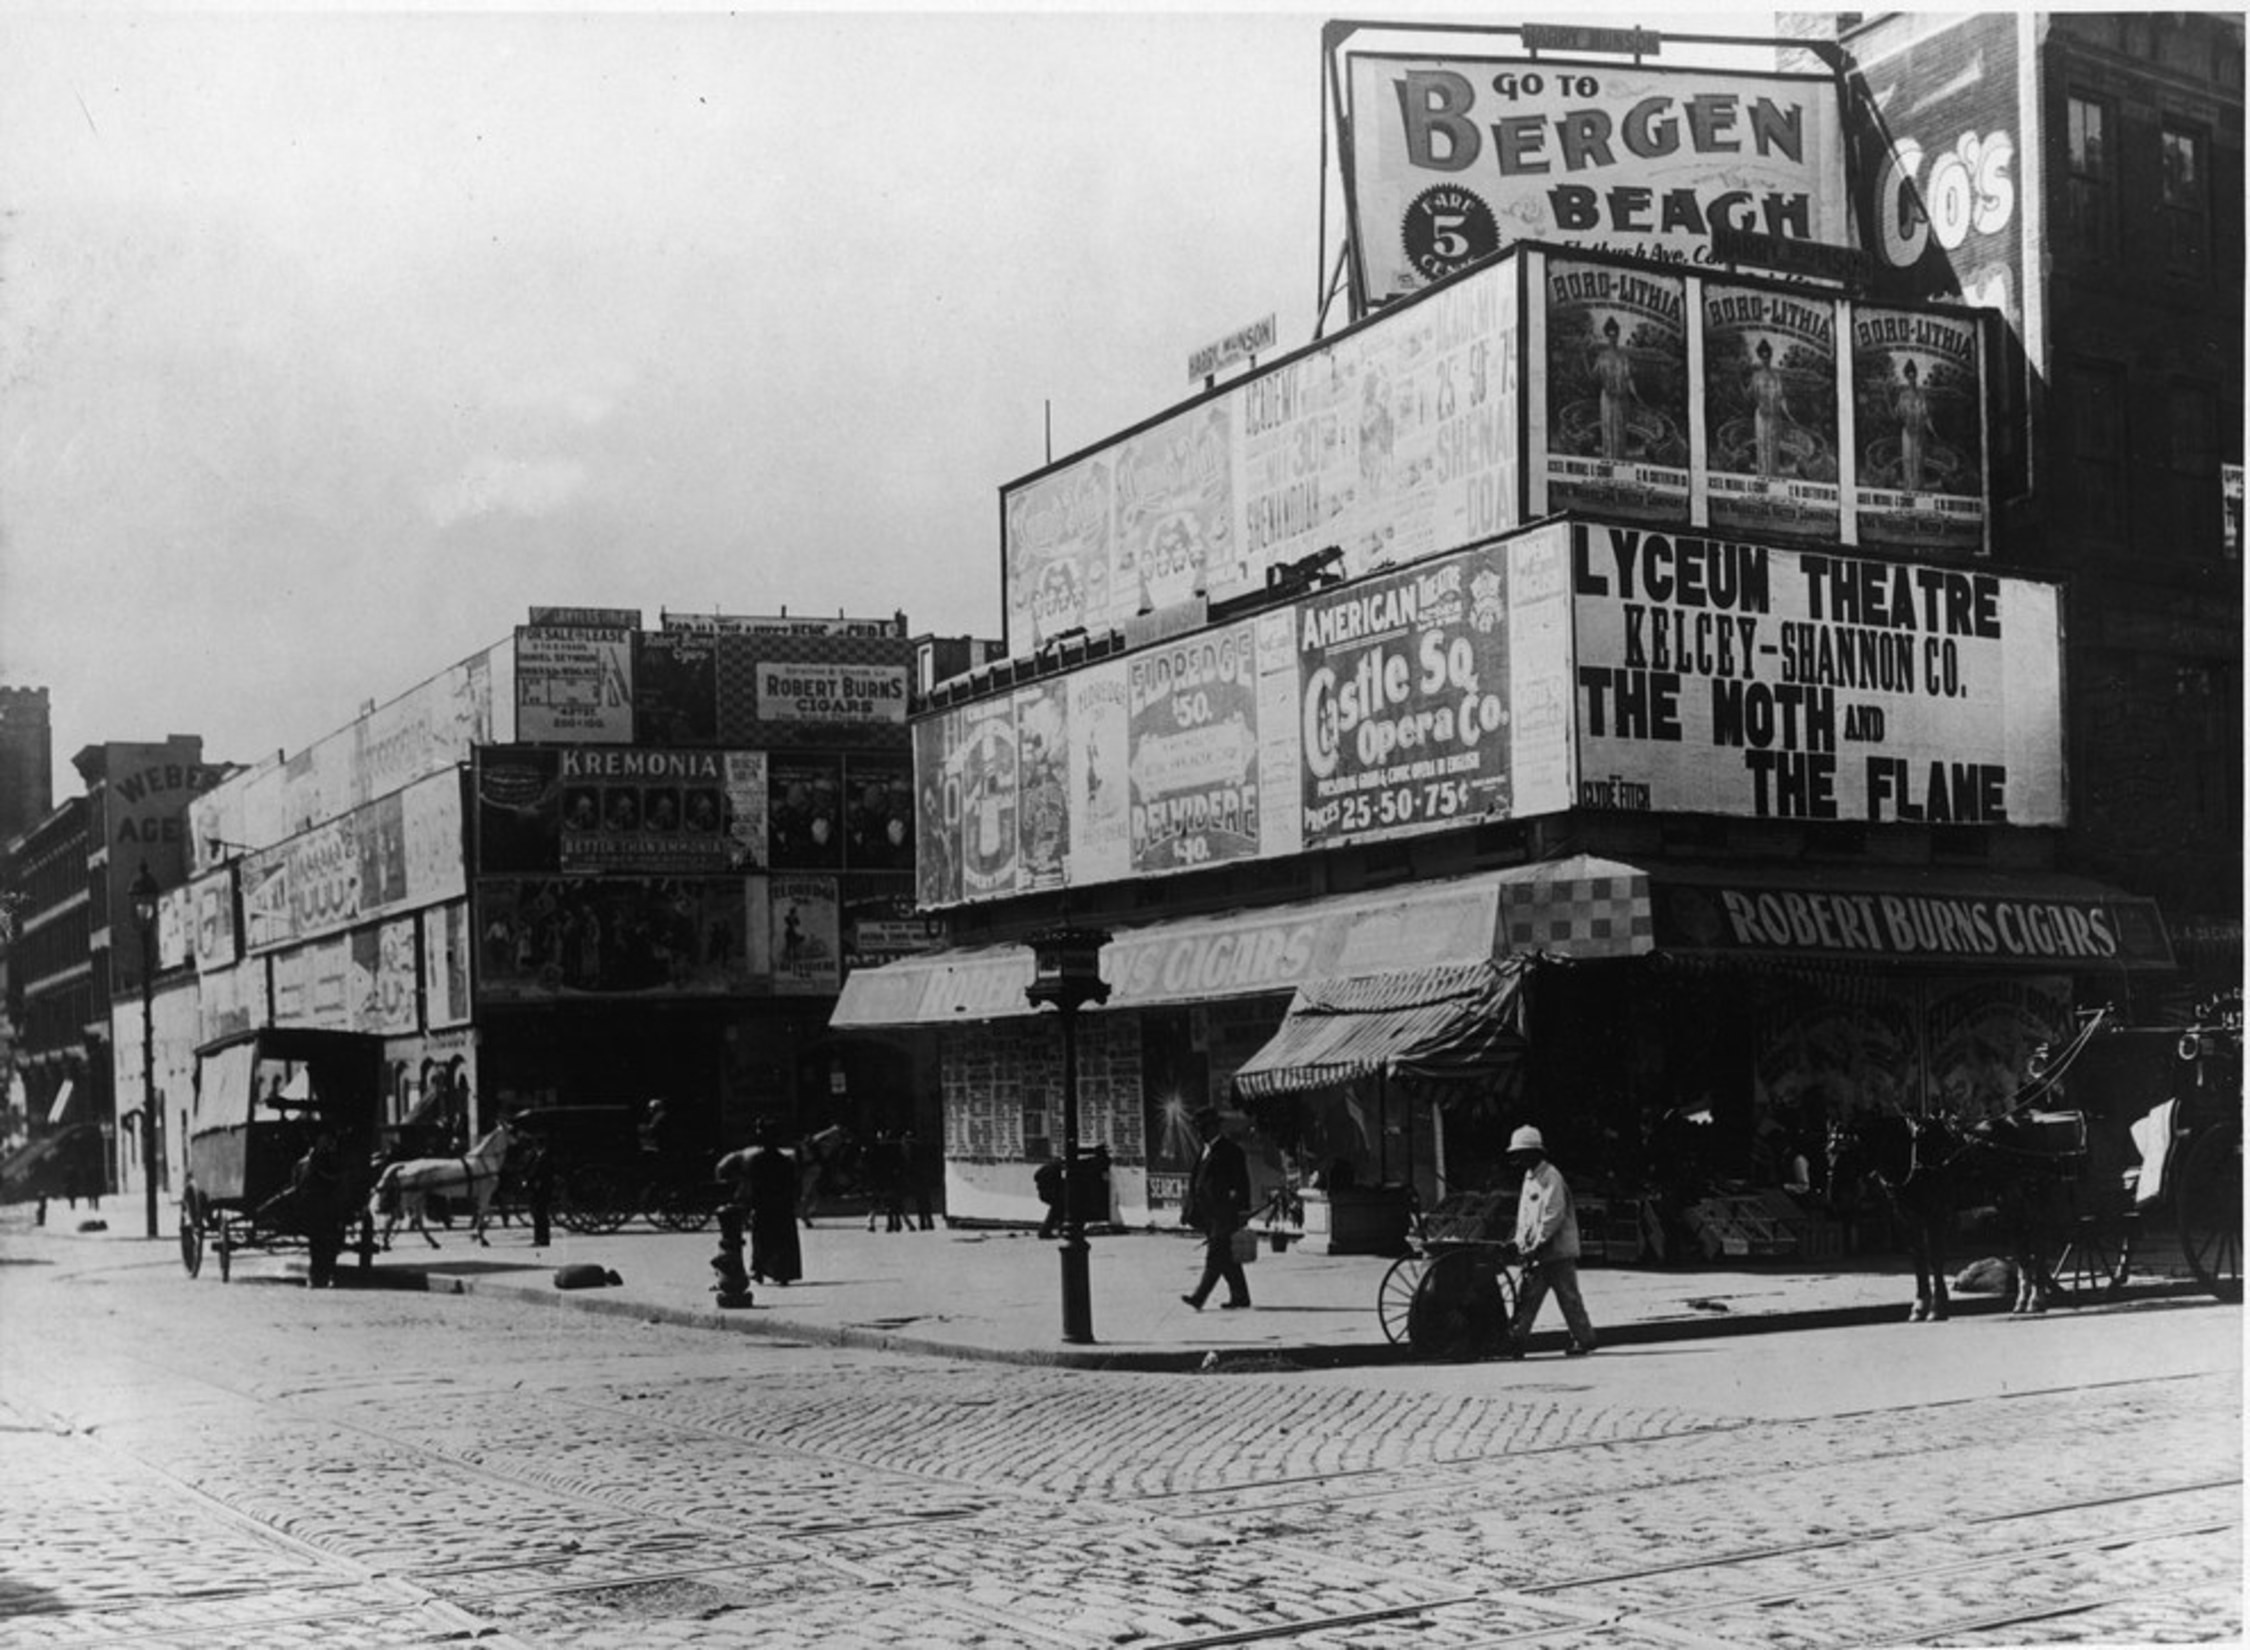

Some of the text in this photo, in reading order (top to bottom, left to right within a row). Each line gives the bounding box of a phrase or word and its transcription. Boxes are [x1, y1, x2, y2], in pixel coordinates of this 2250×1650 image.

[1492, 73, 1599, 101] GO TO
[1393, 69, 1804, 176] BERGEN
[1433, 215, 1469, 258] 5
[1546, 183, 1811, 239] BEACH
[1420, 254, 1478, 277] CEN
[1565, 240, 1647, 261] bush
[1573, 523, 1771, 613] LYCEUM
[1799, 552, 2002, 639] THEATRE
[585, 630, 626, 644] LEASE
[1302, 584, 1417, 651] AMERICAN
[766, 673, 903, 700] ROBERT BURNS
[1924, 637, 1967, 699] CO.
[794, 698, 874, 713] CIGARS
[1356, 694, 1510, 767] Opera Co.
[1578, 665, 1885, 752] THE MOTH AND
[562, 750, 718, 778] KREMONIA
[1745, 749, 2008, 823] THE FLAME
[1721, 890, 2118, 959] ROBERT BURNS CIGARS
[1163, 921, 1317, 992] CIGARS
